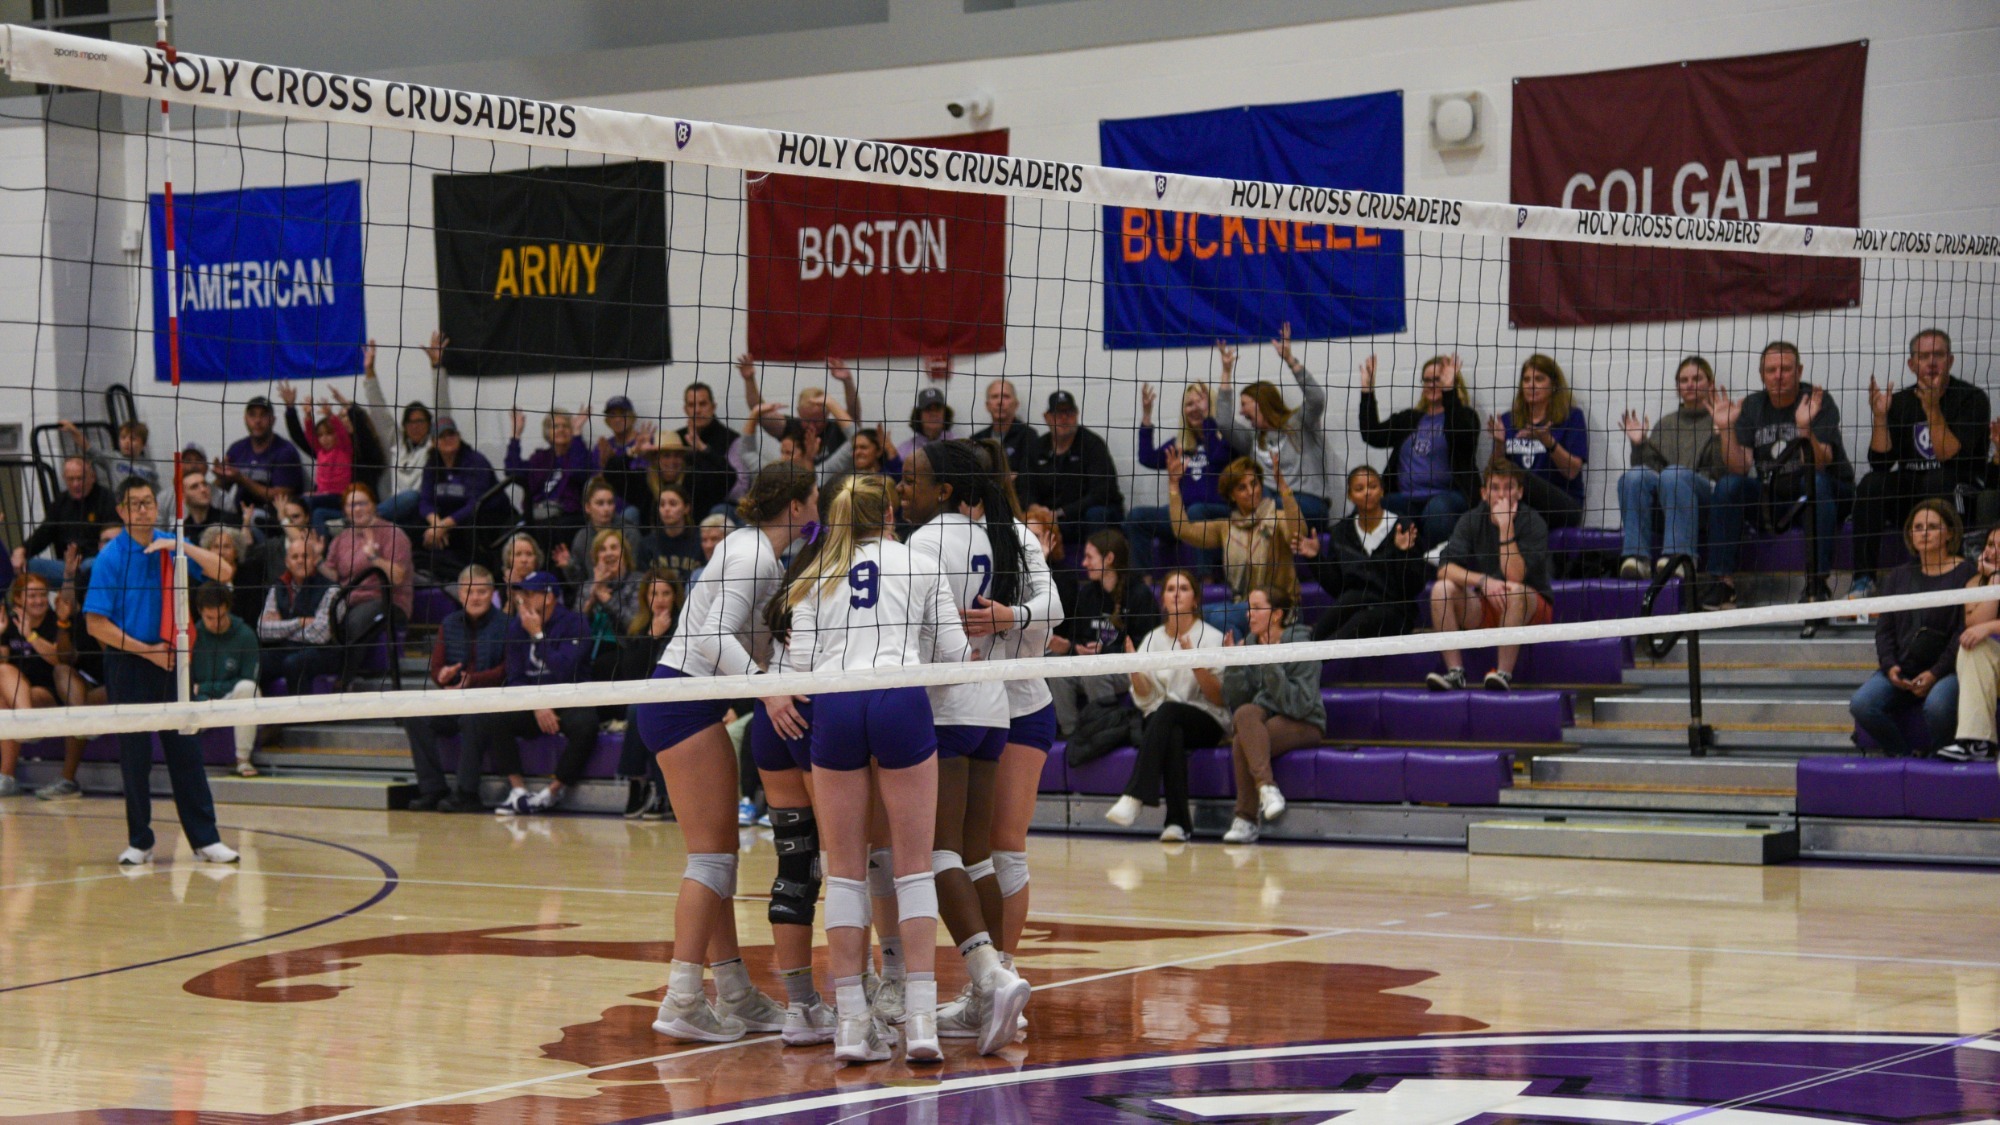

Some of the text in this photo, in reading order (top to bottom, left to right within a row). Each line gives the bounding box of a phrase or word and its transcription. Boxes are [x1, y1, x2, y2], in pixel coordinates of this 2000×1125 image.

[54, 48, 78, 57] sports
[142, 49, 577, 138] HOLY CROSS CRUSADERS
[777, 132, 1084, 193] HOLY CROSS CRUSADERS
[1230, 180, 1463, 226] HOLY CROSS CRUSADERS
[1577, 211, 1762, 244] HOLY CROSS CRUSADERS
[798, 218, 947, 280] BOSTON
[1853, 229, 1887, 251] HOLY
[1890, 231, 1933, 253] CROSS
[180, 257, 335, 311] AMERICAN
[494, 243, 605, 300] ARMY
[848, 560, 879, 610] 9
